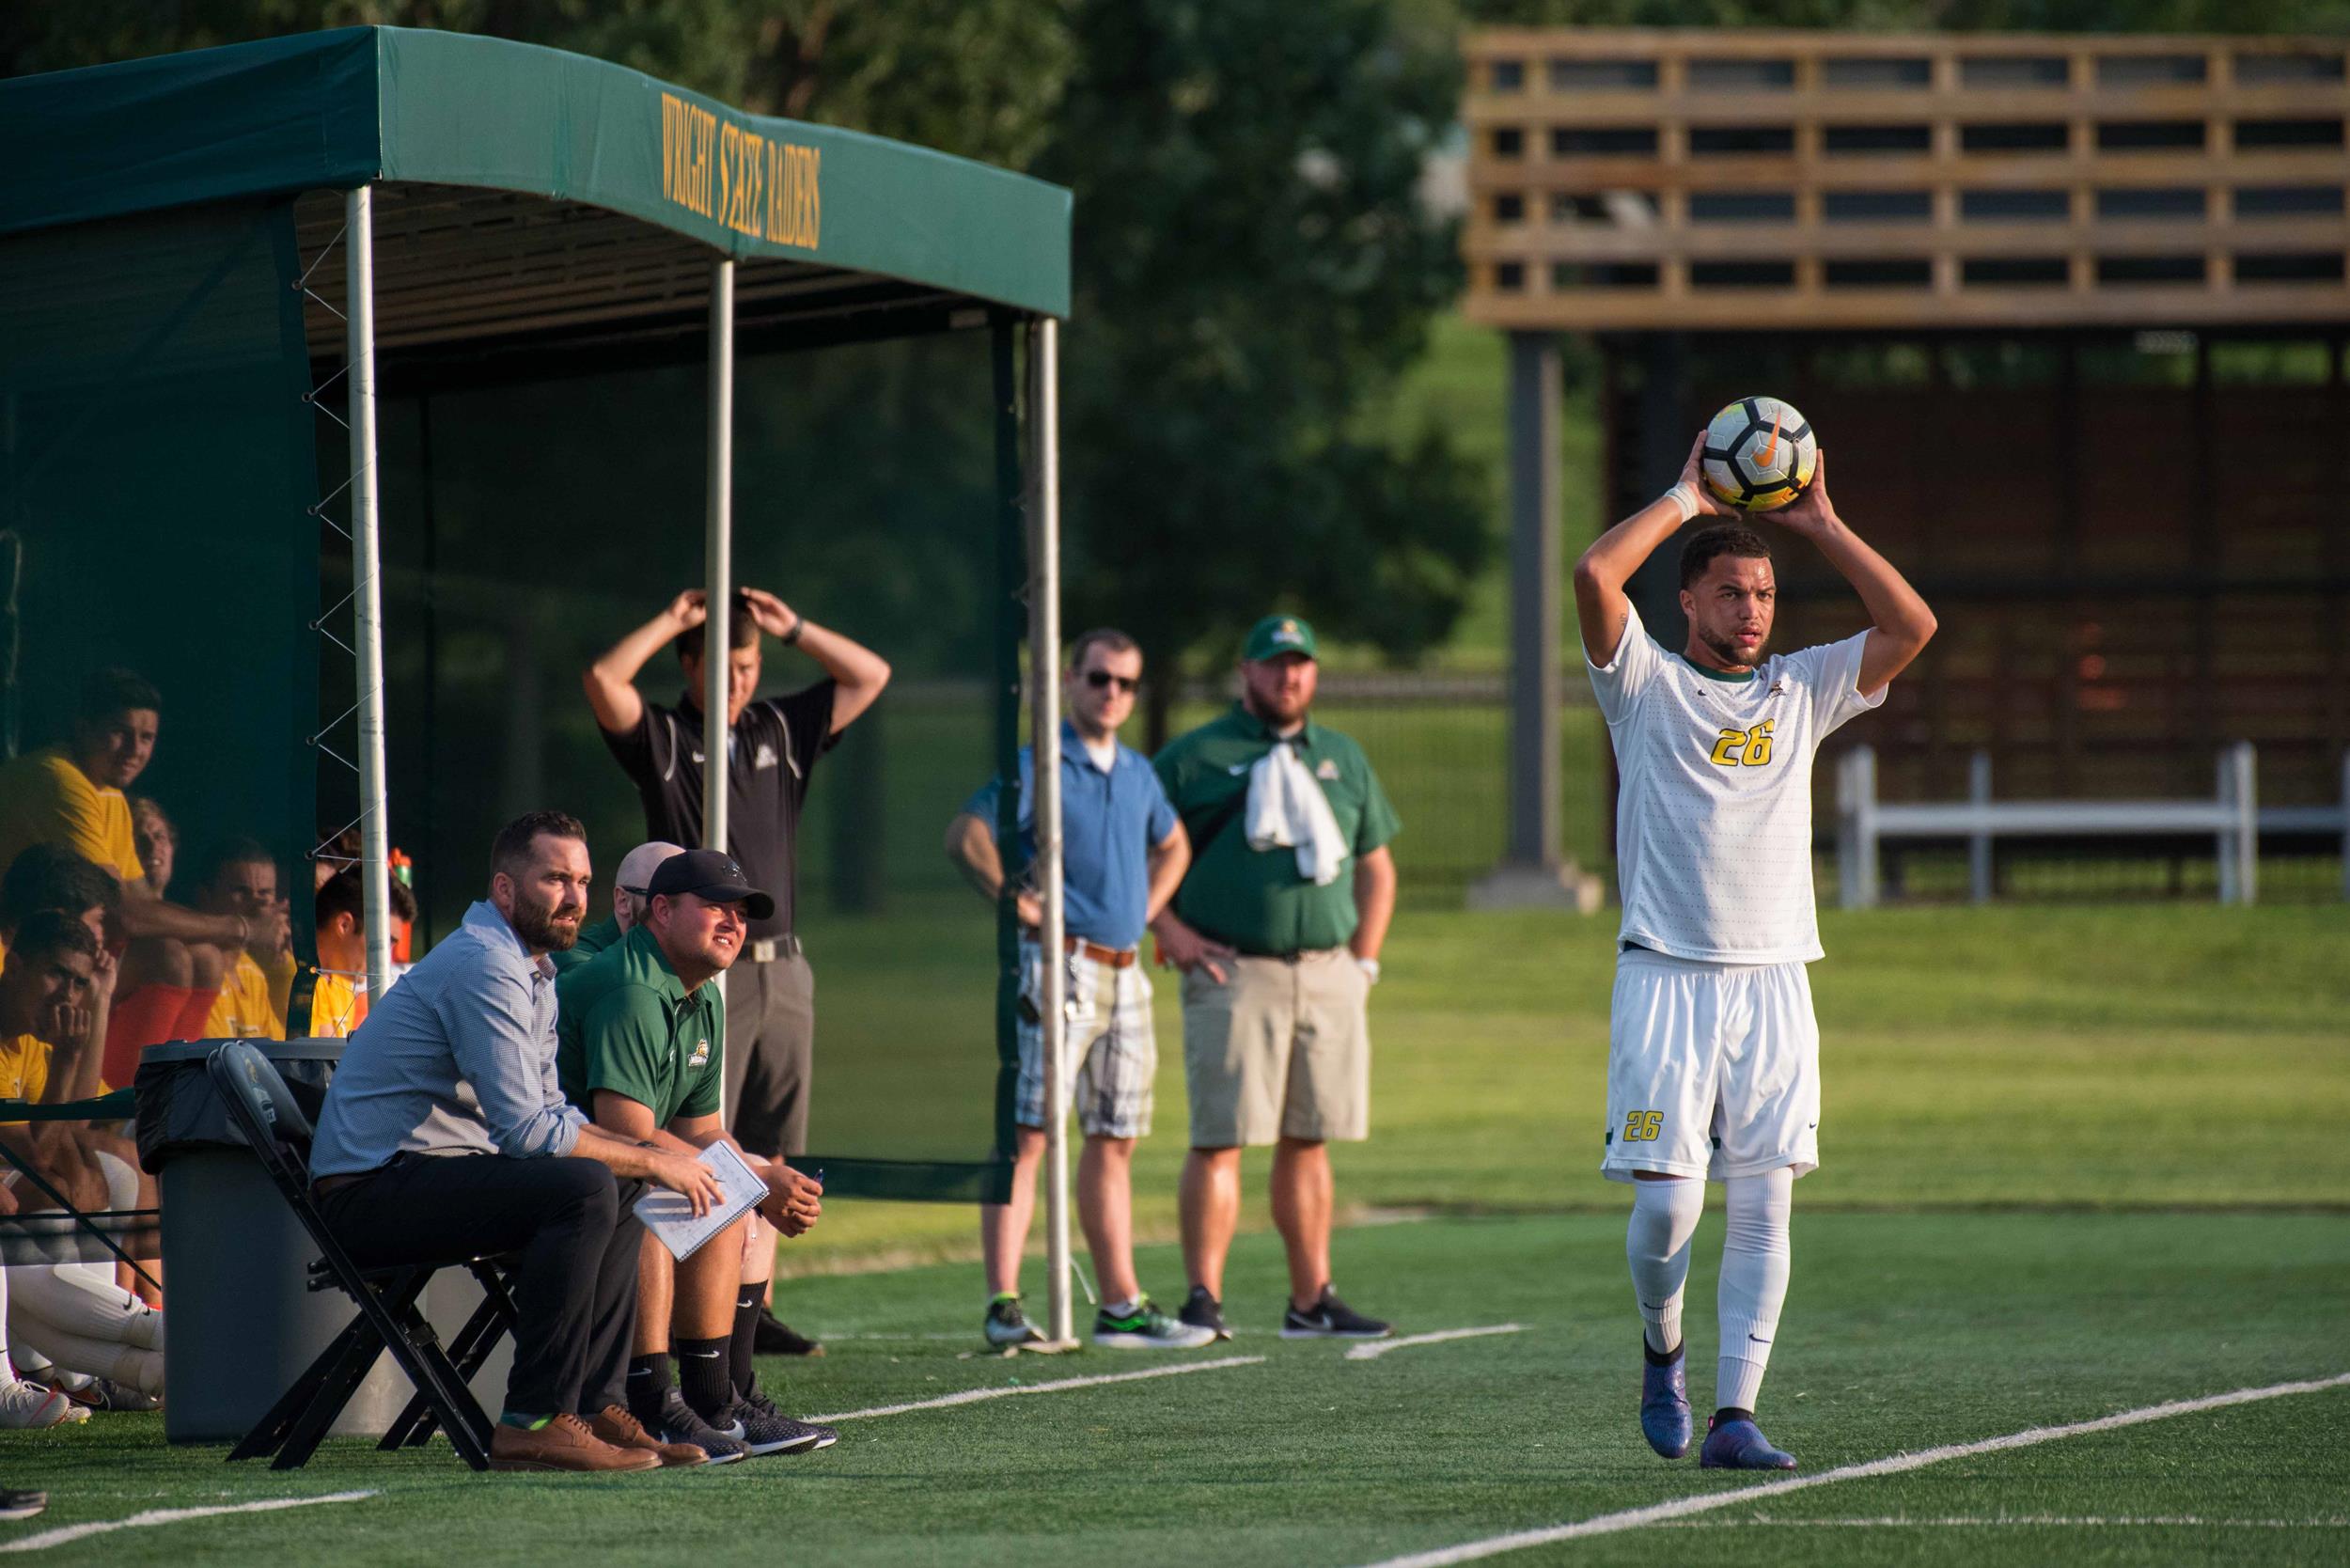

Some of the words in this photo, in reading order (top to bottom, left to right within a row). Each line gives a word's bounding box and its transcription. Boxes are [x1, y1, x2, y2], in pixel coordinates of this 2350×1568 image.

[662, 92, 716, 218] WRIGHT
[718, 120, 763, 238] STATE
[767, 140, 820, 250] RAIDERS
[1711, 718, 1775, 766] 26
[1623, 1111, 1664, 1141] 26
